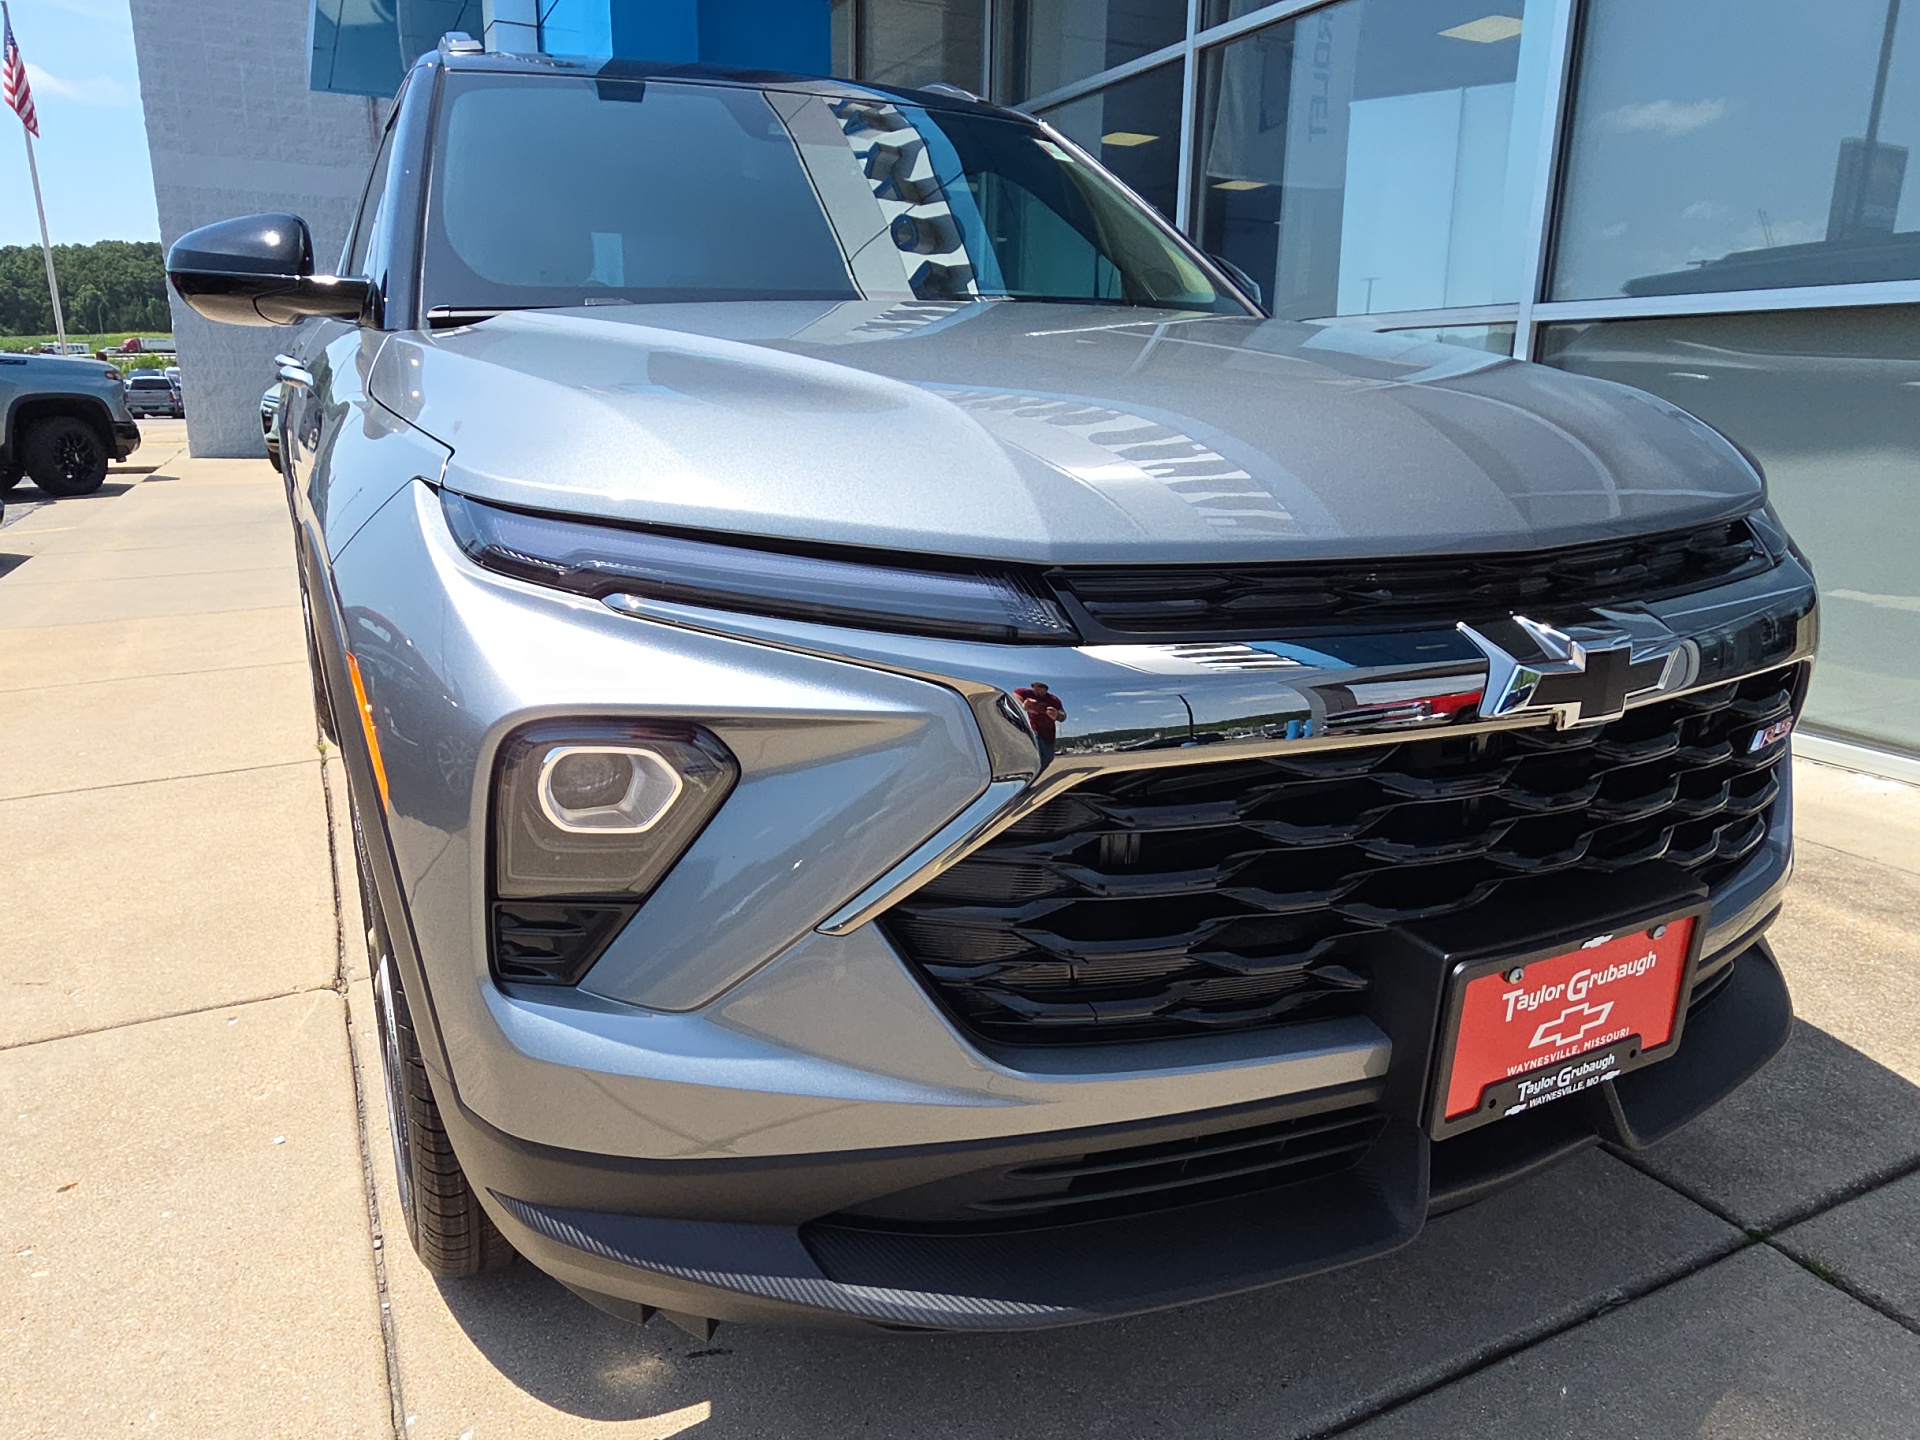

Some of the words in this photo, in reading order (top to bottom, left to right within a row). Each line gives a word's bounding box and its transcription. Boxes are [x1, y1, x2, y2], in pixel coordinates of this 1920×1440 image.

[1502, 983, 1565, 1022] Taylor
[1566, 951, 1657, 1001] Grubaugh
[1506, 1046, 1580, 1077] WAYNESVILLE,
[1583, 1026, 1630, 1051] MISSOURI
[1518, 1075, 1557, 1102] Taylor
[1557, 1053, 1615, 1087] Grubaugh
[1529, 1083, 1585, 1108] WAYNESVILLE,
[1586, 1075, 1600, 1088] MO
